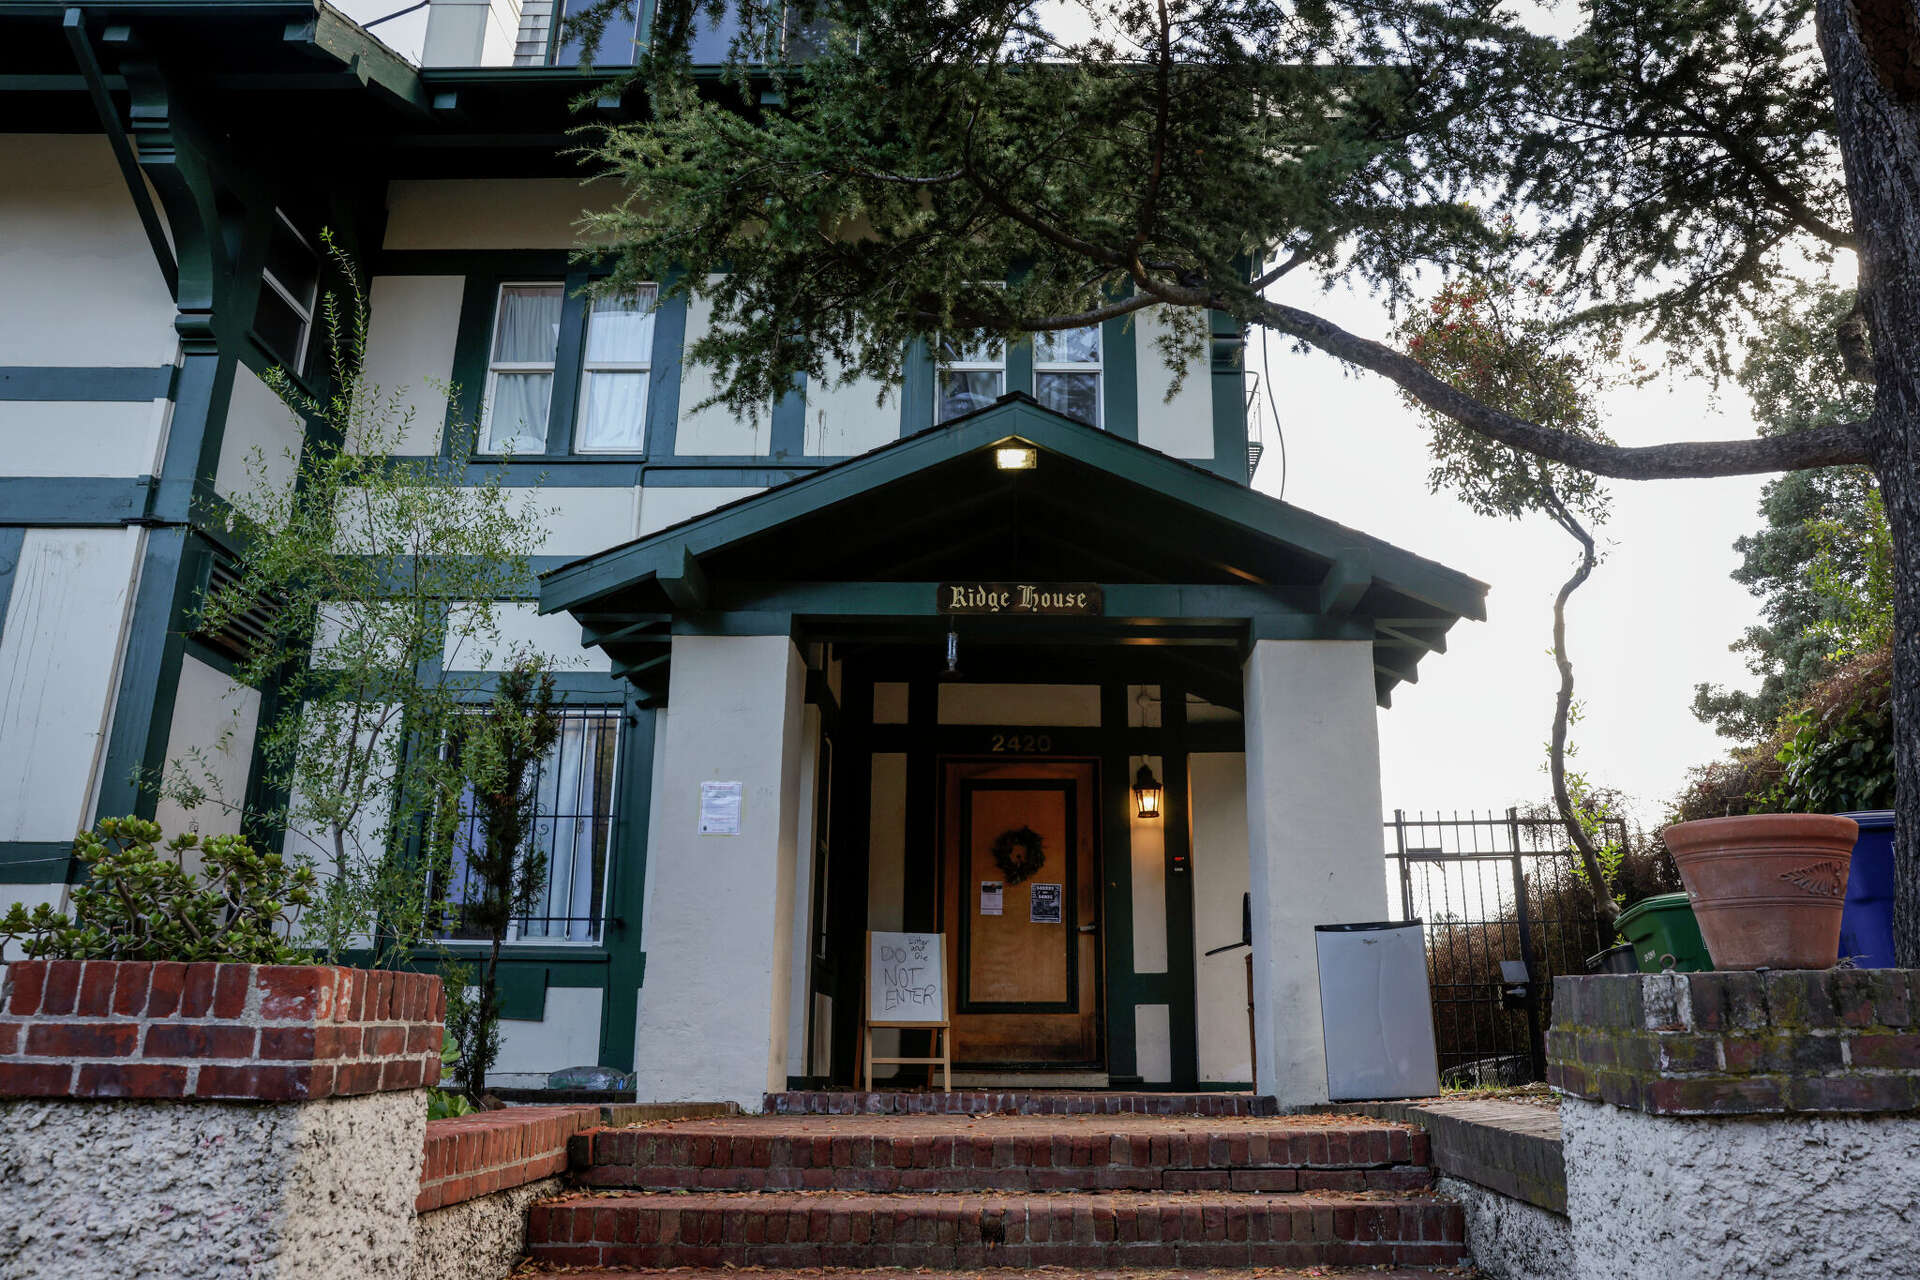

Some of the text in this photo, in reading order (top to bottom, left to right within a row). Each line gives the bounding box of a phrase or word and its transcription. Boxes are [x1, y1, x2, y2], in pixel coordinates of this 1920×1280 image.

[950, 584, 1088, 612] Ridge House
[991, 734, 1053, 752] 2420
[880, 945, 907, 964] DO
[884, 963, 925, 989] NOT
[885, 983, 938, 1011] ENTER
